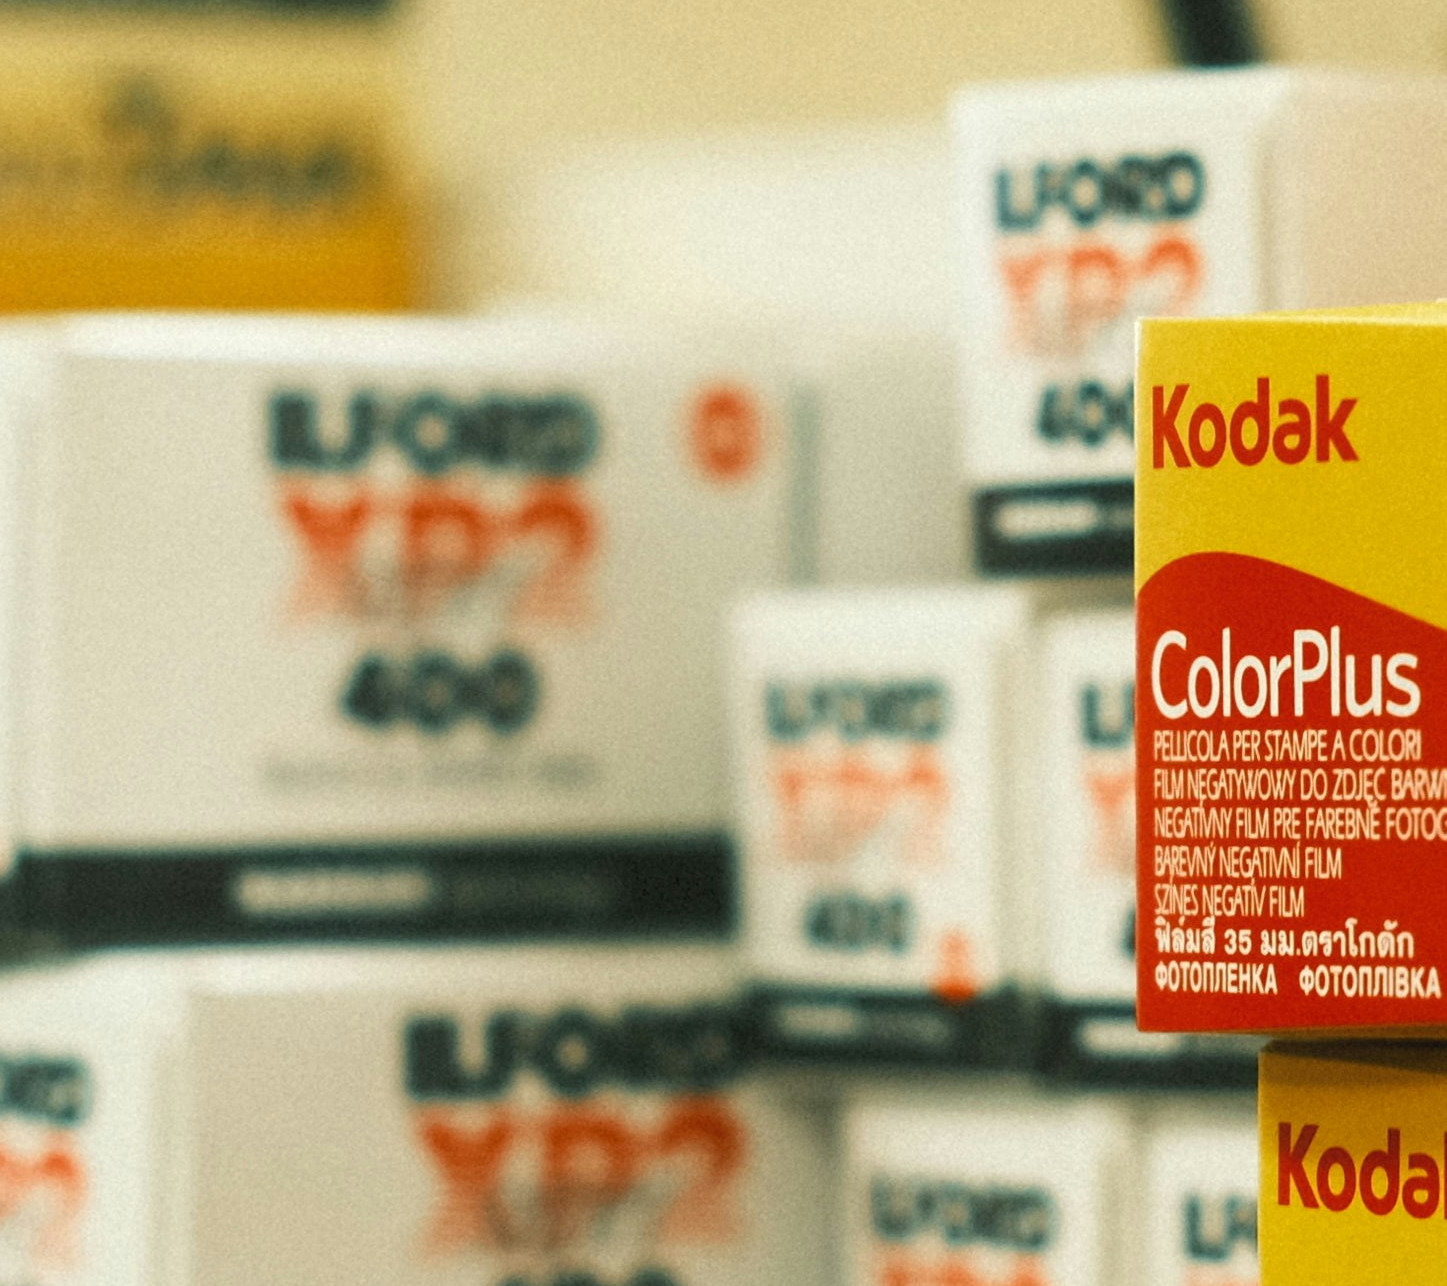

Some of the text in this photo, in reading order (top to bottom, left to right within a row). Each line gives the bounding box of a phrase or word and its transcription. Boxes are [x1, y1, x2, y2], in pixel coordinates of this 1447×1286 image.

[1152, 374, 1359, 469] Kodak
[1151, 625, 1422, 719] ColorPlus
[1154, 729, 1422, 761] PELLICOLA PER STAMPE A COLORI
[1154, 768, 1184, 800] FILM
[1187, 768, 1297, 800] NEGATYWOWY
[1300, 768, 1327, 800] DO
[1236, 807, 1270, 839] FILM
[1273, 807, 1301, 839] PRE
[1304, 847, 1342, 879] FILM
[1269, 885, 1304, 917] FILM
[1224, 929, 1252, 955] 35
[1154, 961, 1442, 999] ФОТОПЛЕНКА ФОТОПЛІВКА
